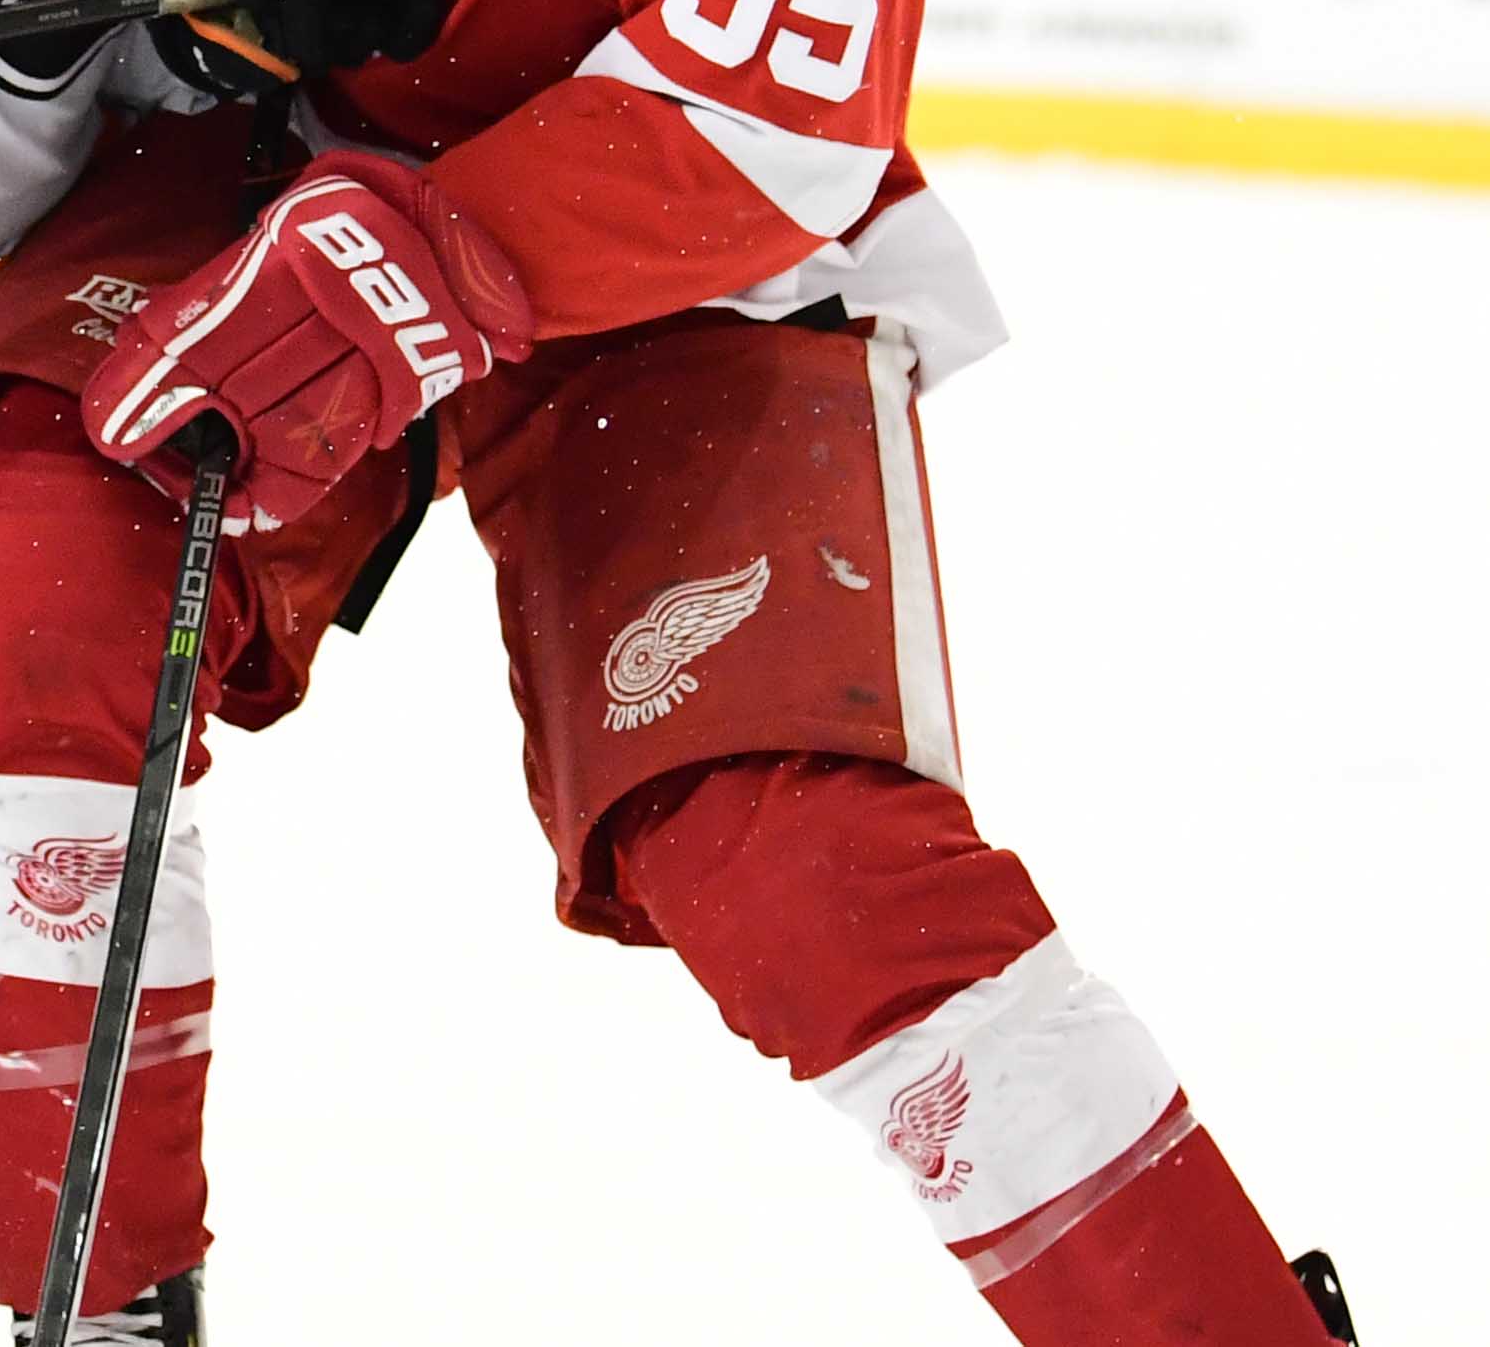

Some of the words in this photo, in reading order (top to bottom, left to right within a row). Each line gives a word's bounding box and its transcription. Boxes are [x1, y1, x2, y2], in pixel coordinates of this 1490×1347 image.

[296, 211, 465, 414] BAUE
[170, 471, 226, 659] RIBCORE
[601, 672, 700, 732] TORONTO
[6, 900, 108, 943] TORONTO
